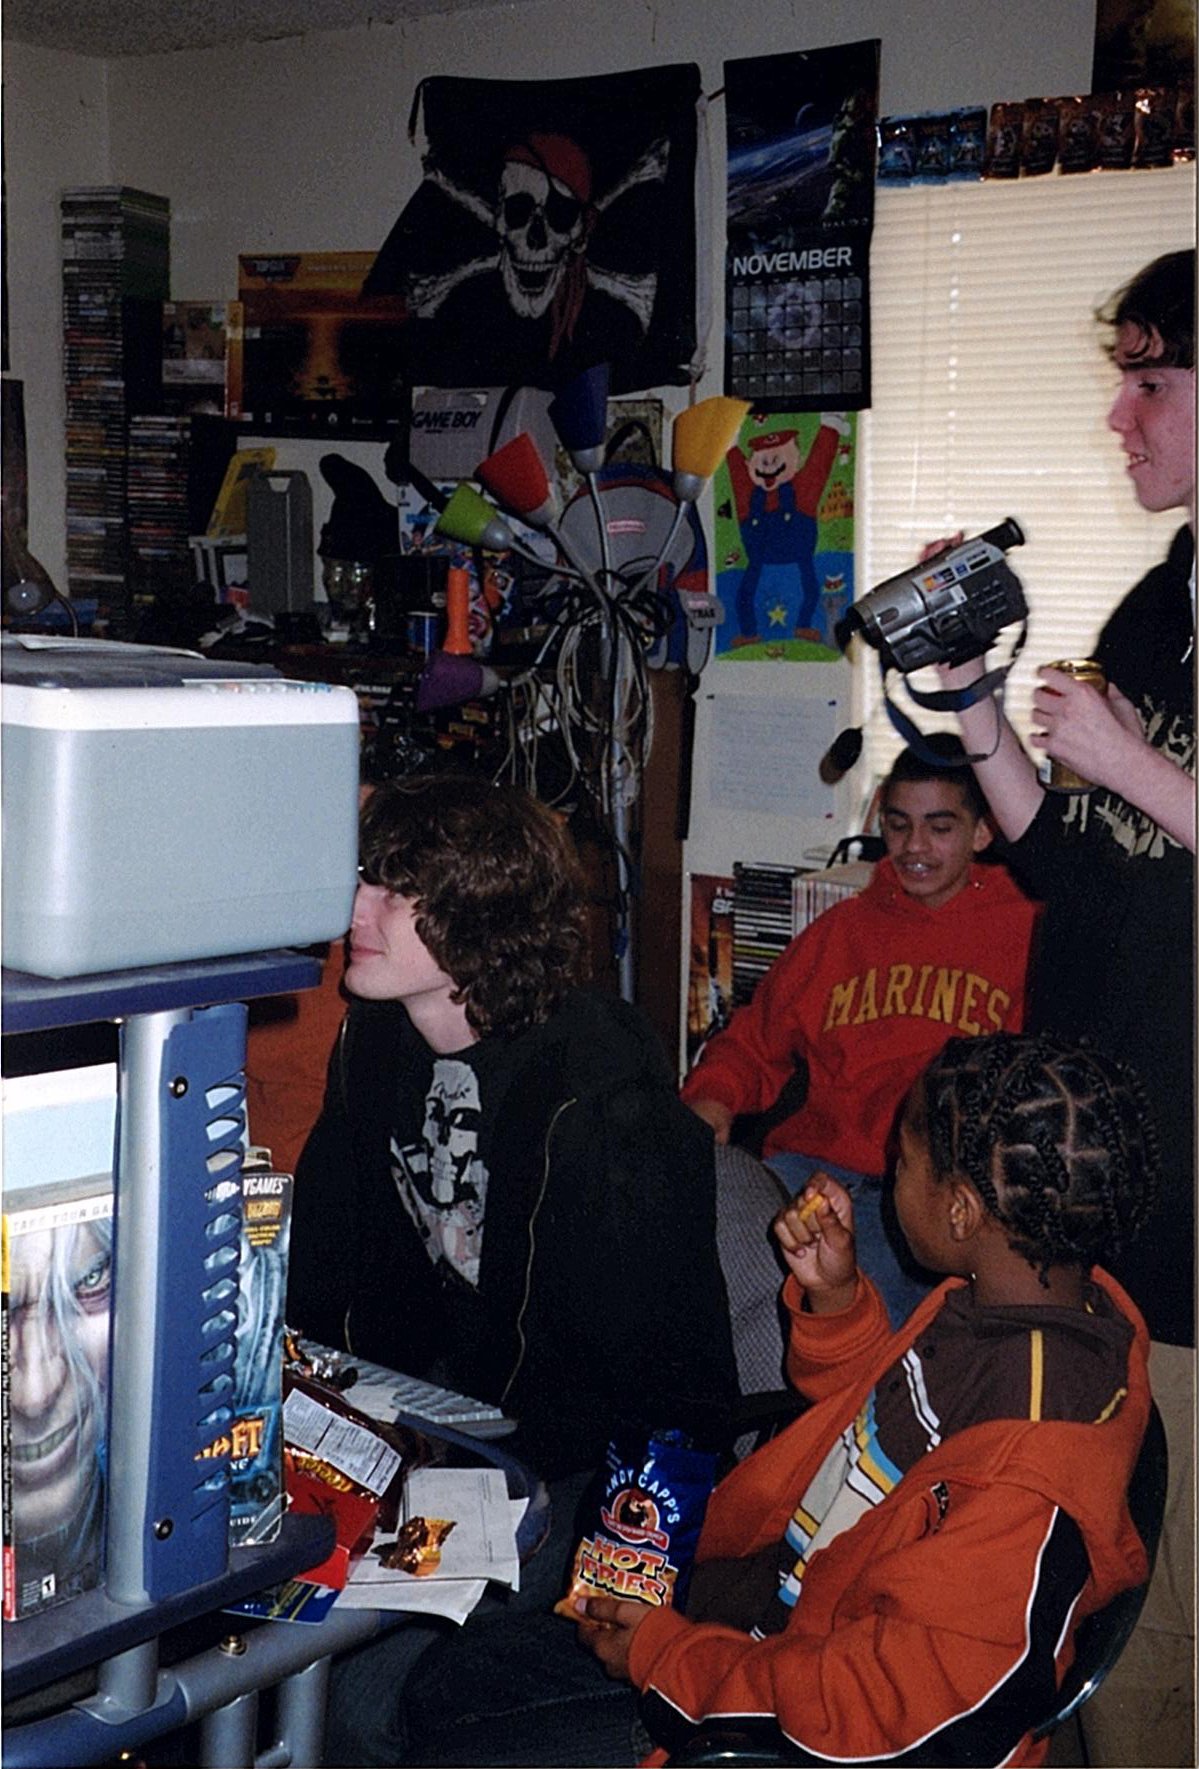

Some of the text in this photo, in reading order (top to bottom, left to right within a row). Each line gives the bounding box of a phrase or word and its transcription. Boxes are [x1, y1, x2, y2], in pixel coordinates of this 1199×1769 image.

[732, 246, 853, 277] NOVEMBER
[411, 410, 482, 428] GAME BOY
[822, 963, 1011, 1036] MARINES
[605, 1469, 681, 1524] ANDY CAPP'S
[229, 1516, 257, 1528] UIDE
[592, 1536, 666, 1578] HOT
[582, 1556, 664, 1606] FRIES
